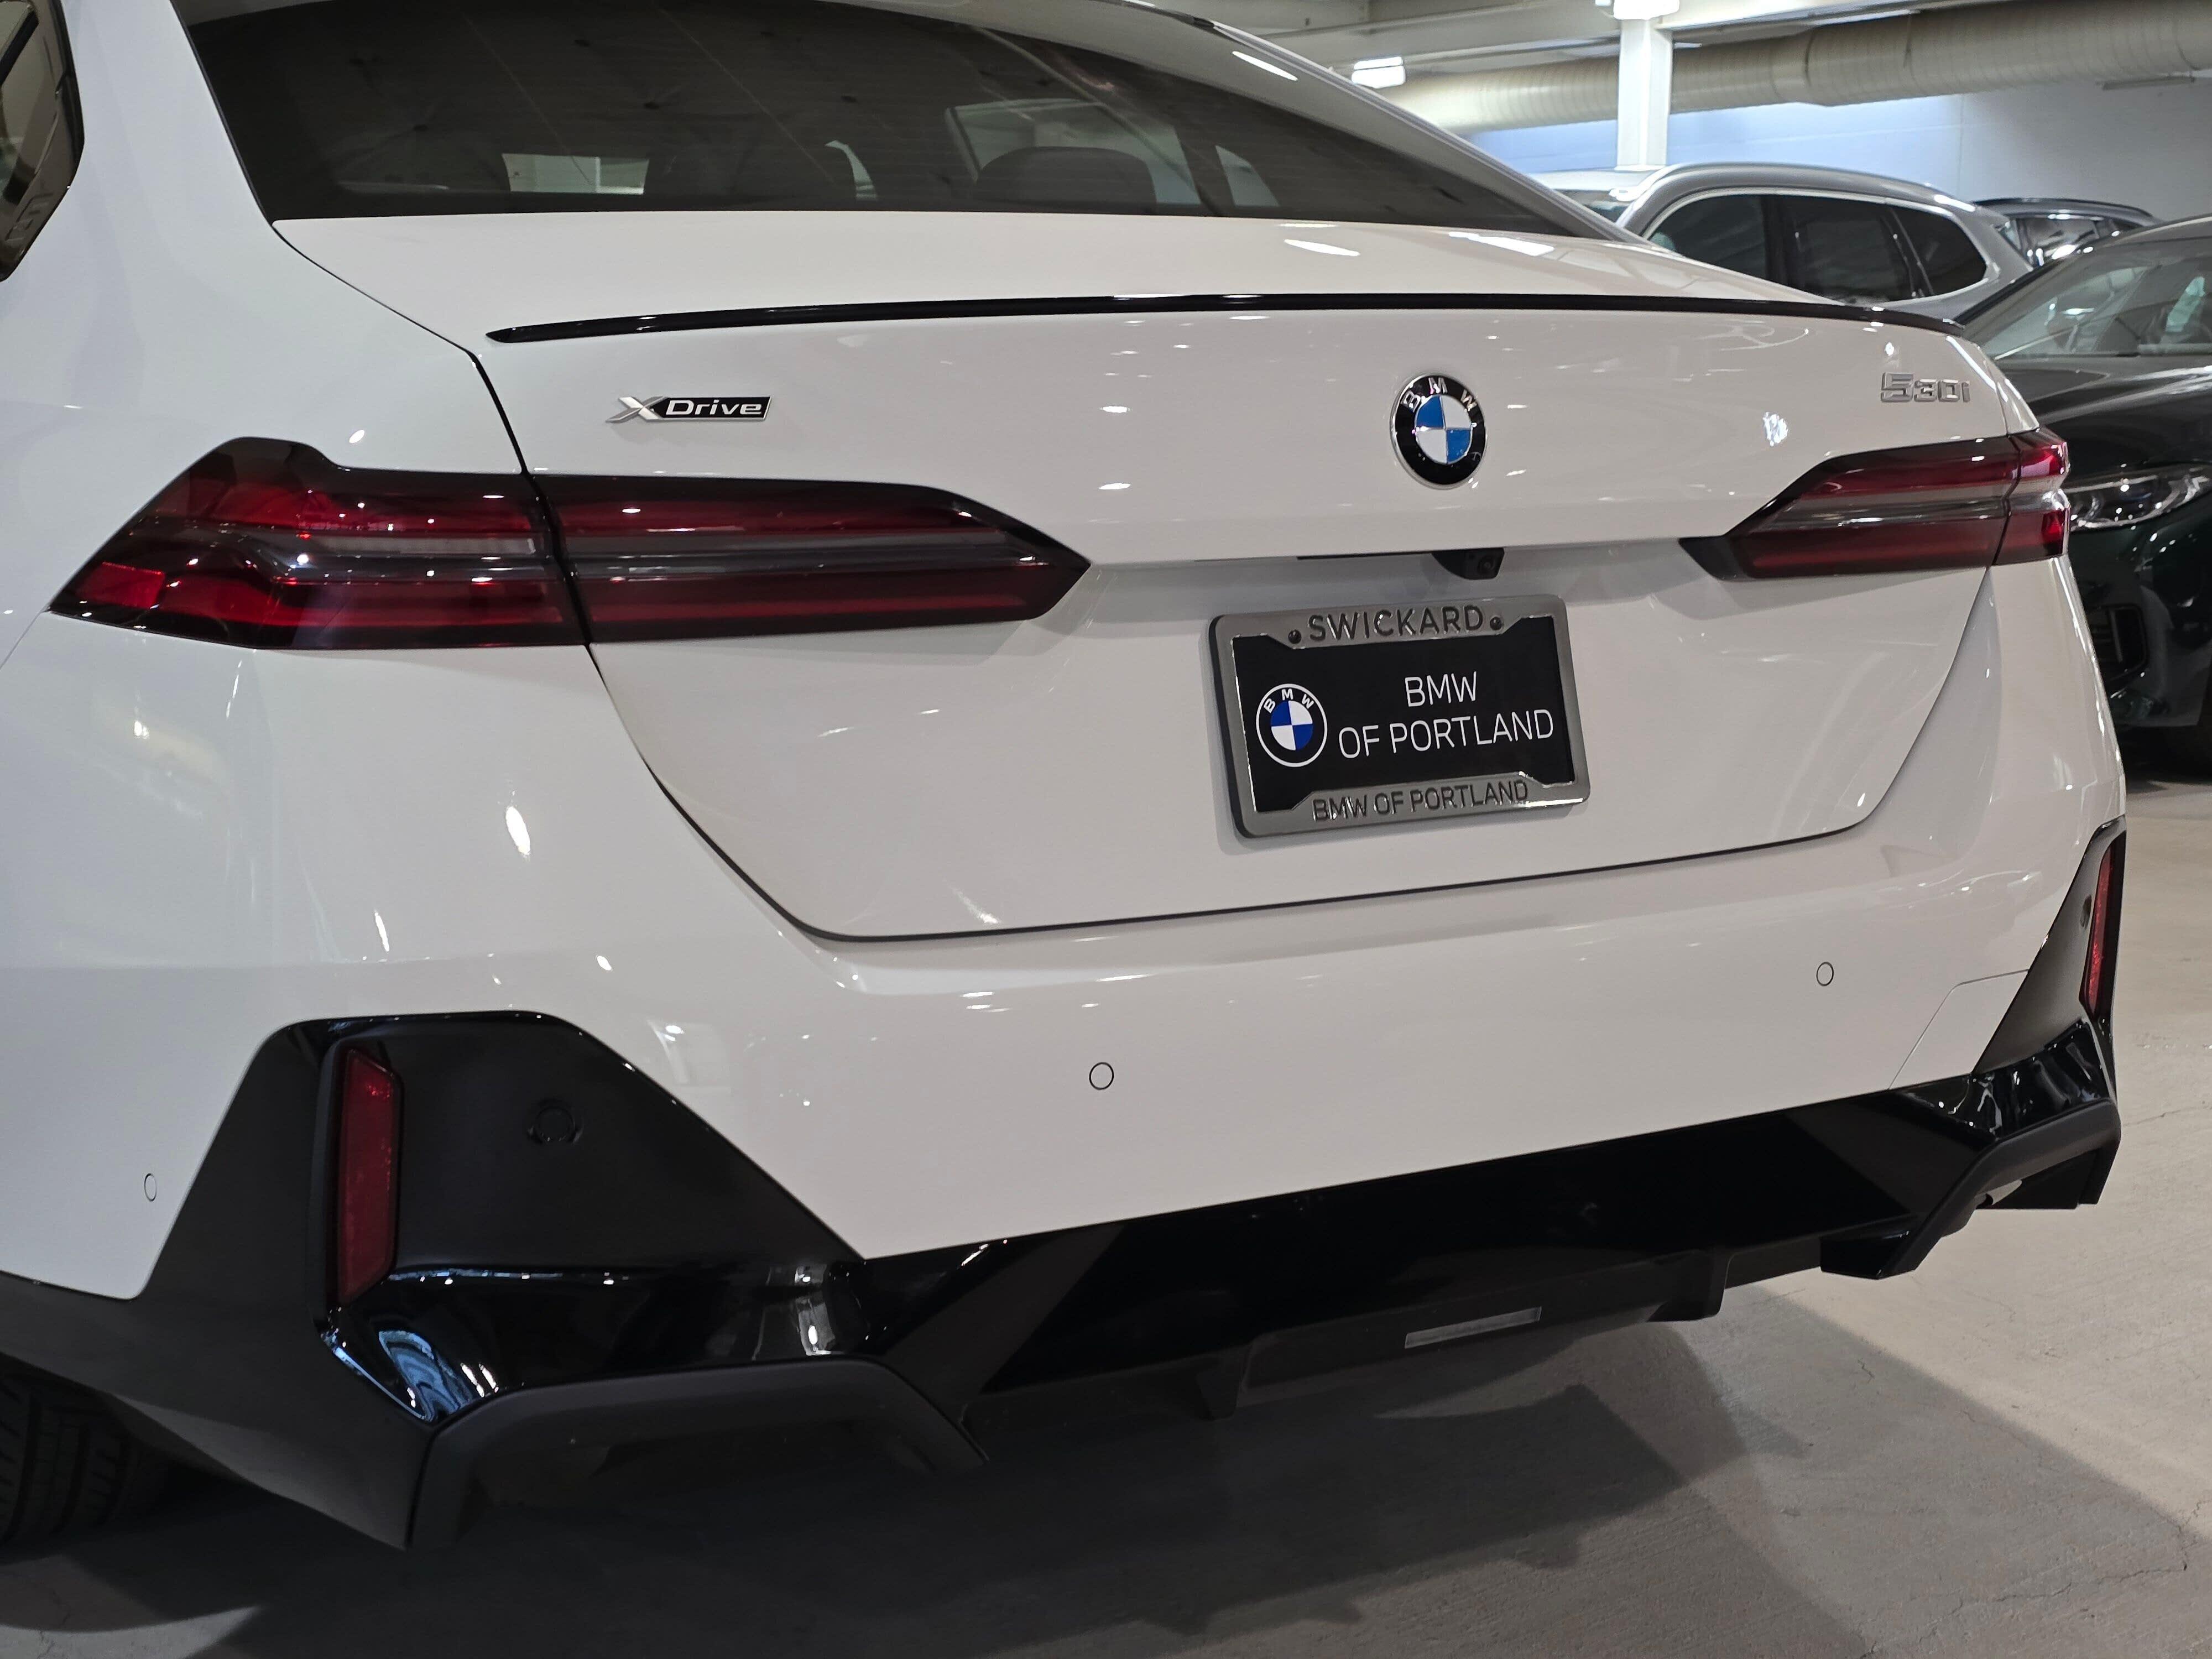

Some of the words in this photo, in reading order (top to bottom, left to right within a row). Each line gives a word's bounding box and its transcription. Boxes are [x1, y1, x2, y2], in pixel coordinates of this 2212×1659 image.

[1400, 377, 1477, 413] BMW
[1880, 372, 1970, 403] 530i
[1307, 604, 1484, 641] SWICKARD
[1263, 688, 1314, 713] BMW
[1405, 671, 1477, 707] BMW
[1338, 724, 1380, 759] OF
[1389, 708, 1554, 754] PORTLAND
[1312, 794, 1368, 822] BMW
[1373, 791, 1404, 815] OF
[1410, 779, 1528, 812] PORTLAND
